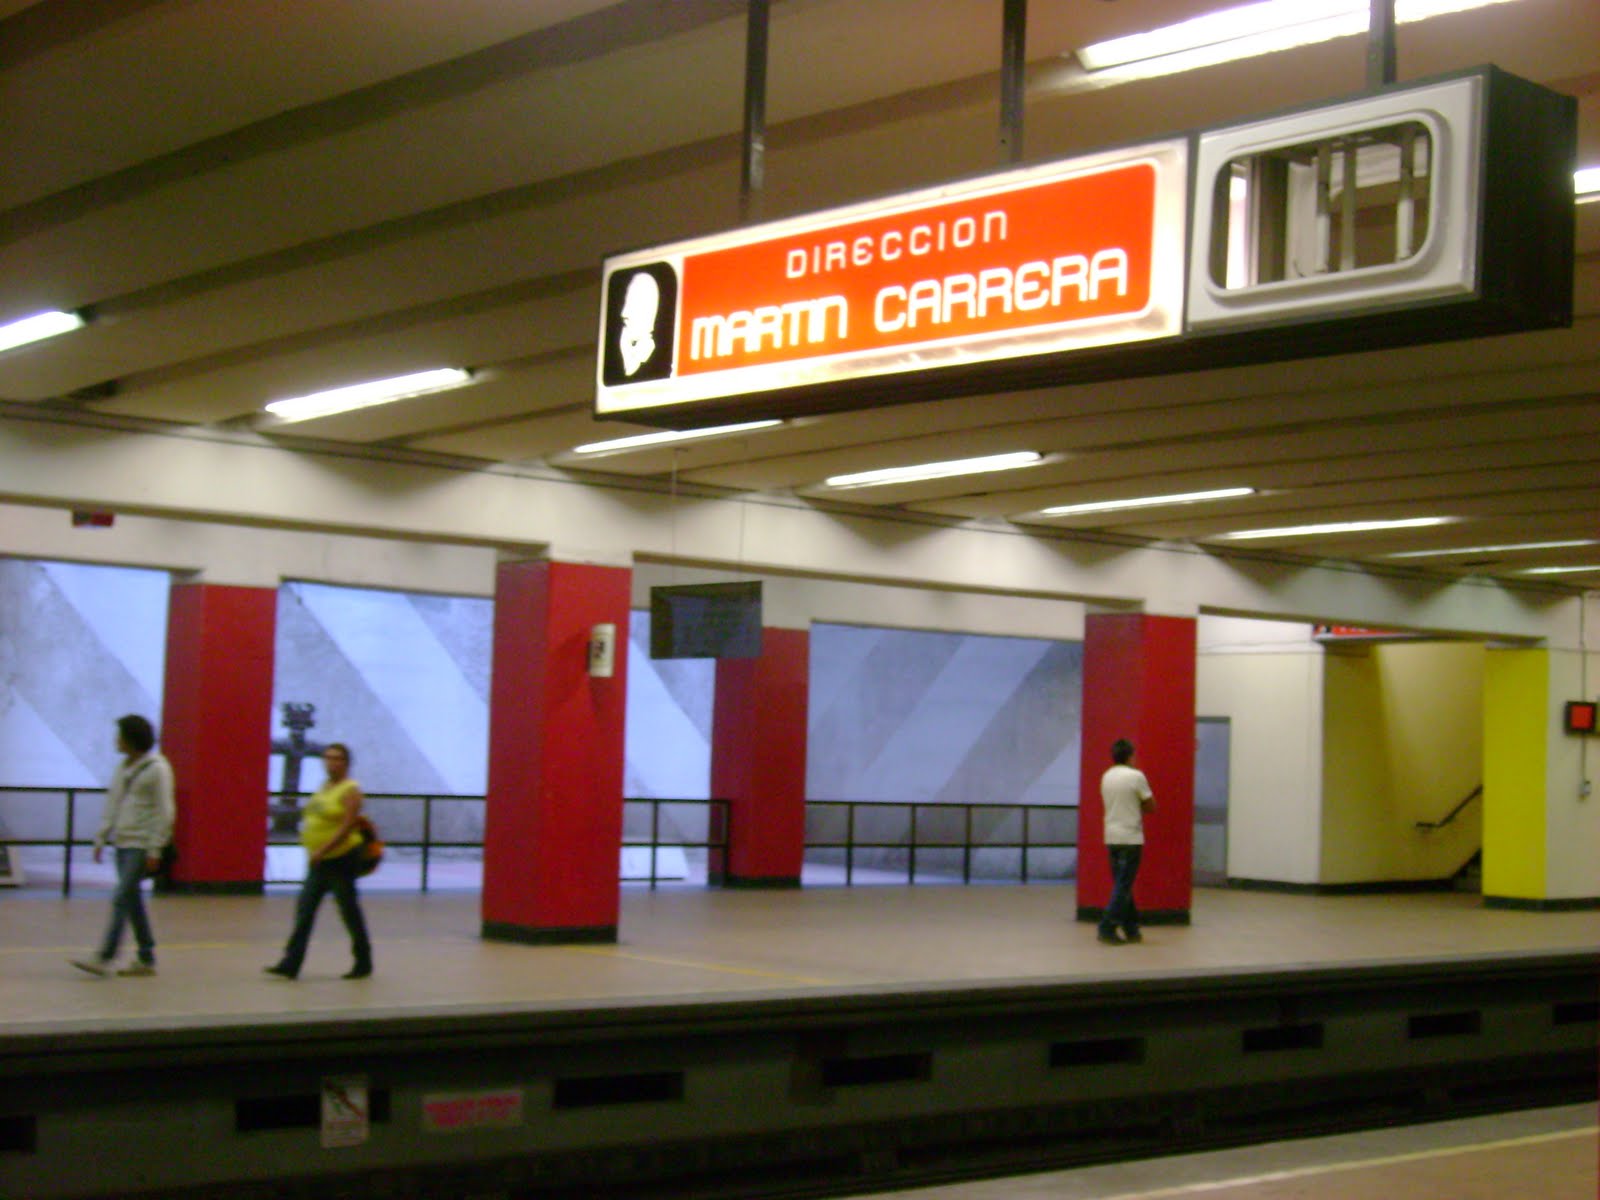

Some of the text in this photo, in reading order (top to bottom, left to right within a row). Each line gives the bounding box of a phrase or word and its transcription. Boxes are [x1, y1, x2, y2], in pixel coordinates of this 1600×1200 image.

[786, 211, 1008, 279] DIRECCION
[691, 248, 1128, 361] MARTIN CARRERA
